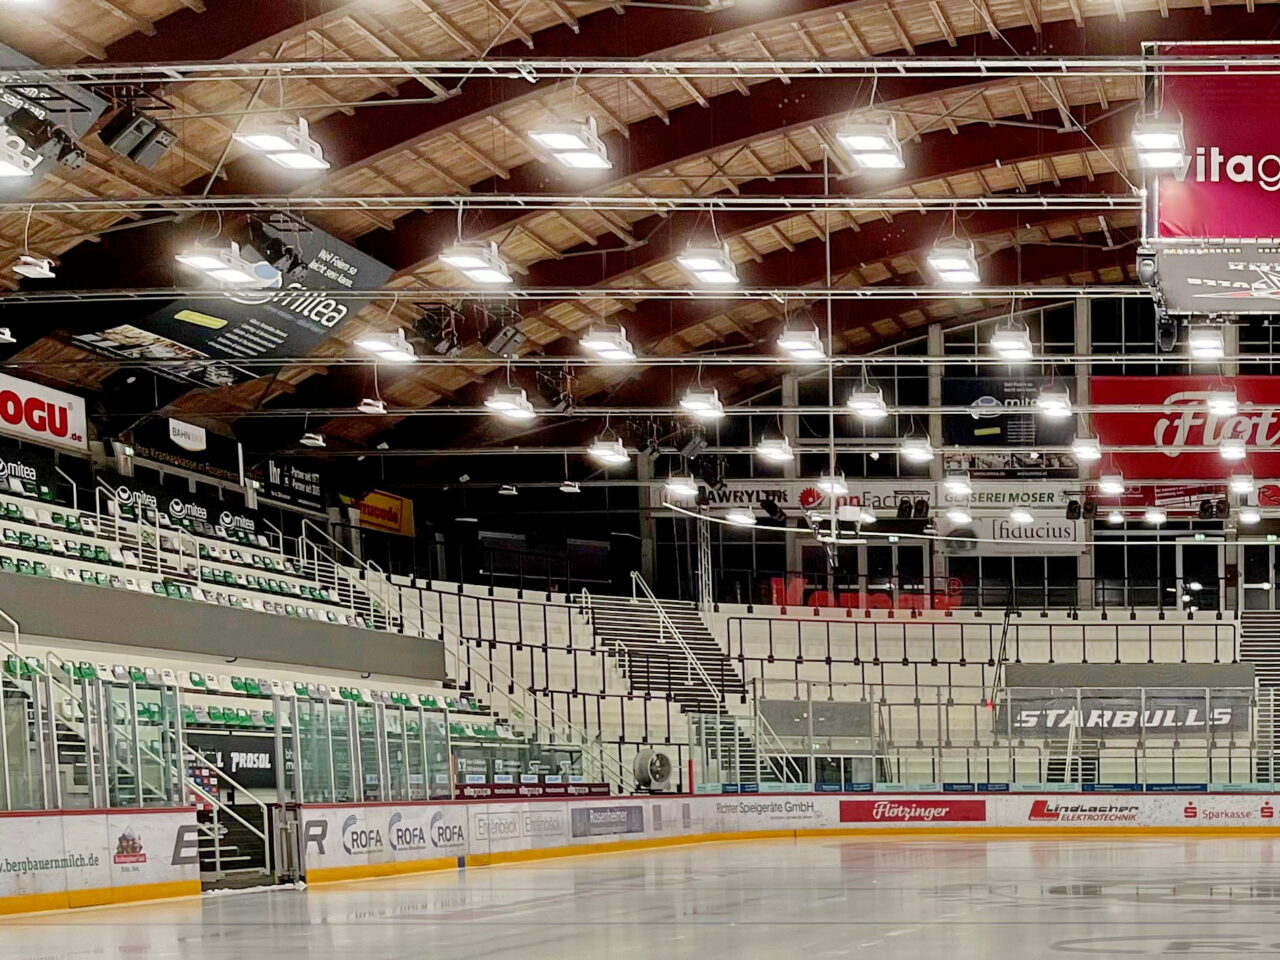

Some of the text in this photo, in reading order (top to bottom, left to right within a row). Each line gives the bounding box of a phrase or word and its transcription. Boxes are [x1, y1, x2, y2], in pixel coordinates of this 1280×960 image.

[0, 390, 69, 437] OGU
[7, 461, 37, 481] mitea
[132, 490, 157, 507] mitea
[1008, 492, 1055, 503] MOSER
[184, 502, 207, 519] mitea
[233, 514, 255, 530] mitea
[1014, 707, 1233, 728] STARBULLS
[230, 751, 272, 773] PROSOL
[739, 802, 783, 815] Spielgeräte
[785, 801, 815, 813] GmbH
[872, 801, 949, 820] Flötzinger
[1202, 809, 1252, 819] Sparkasse
[1060, 813, 1137, 821] ELEKTROTECHNIK
[351, 829, 383, 849] ROFA
[396, 826, 426, 845] ROFA
[437, 825, 465, 842] ROFA
